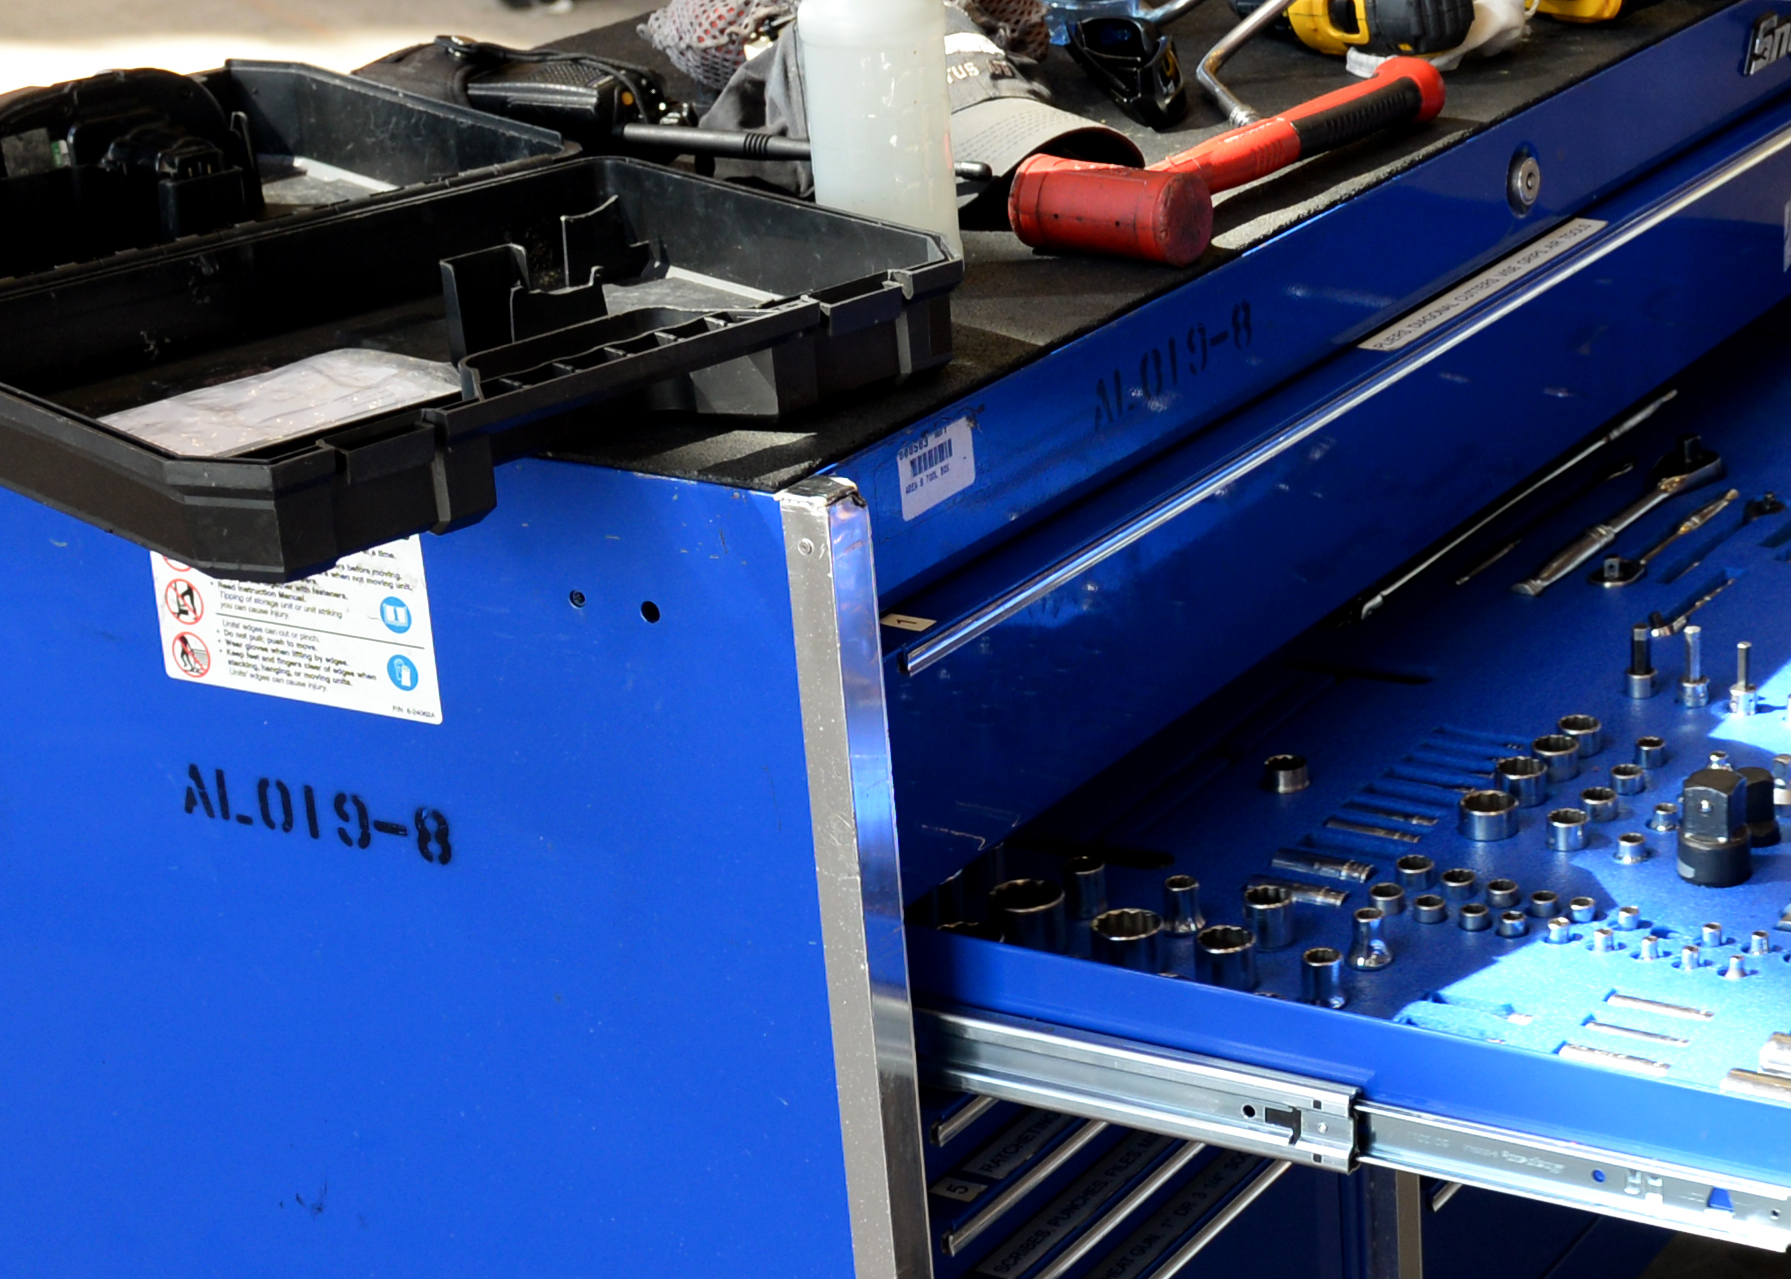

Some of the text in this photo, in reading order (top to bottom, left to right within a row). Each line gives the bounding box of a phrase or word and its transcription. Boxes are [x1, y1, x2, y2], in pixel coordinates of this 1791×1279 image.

[1095, 299, 1252, 432] AL019-8
[220, 590, 244, 602] Tipping
[184, 763, 452, 865] AL019-8
[946, 1184, 970, 1195] 5
